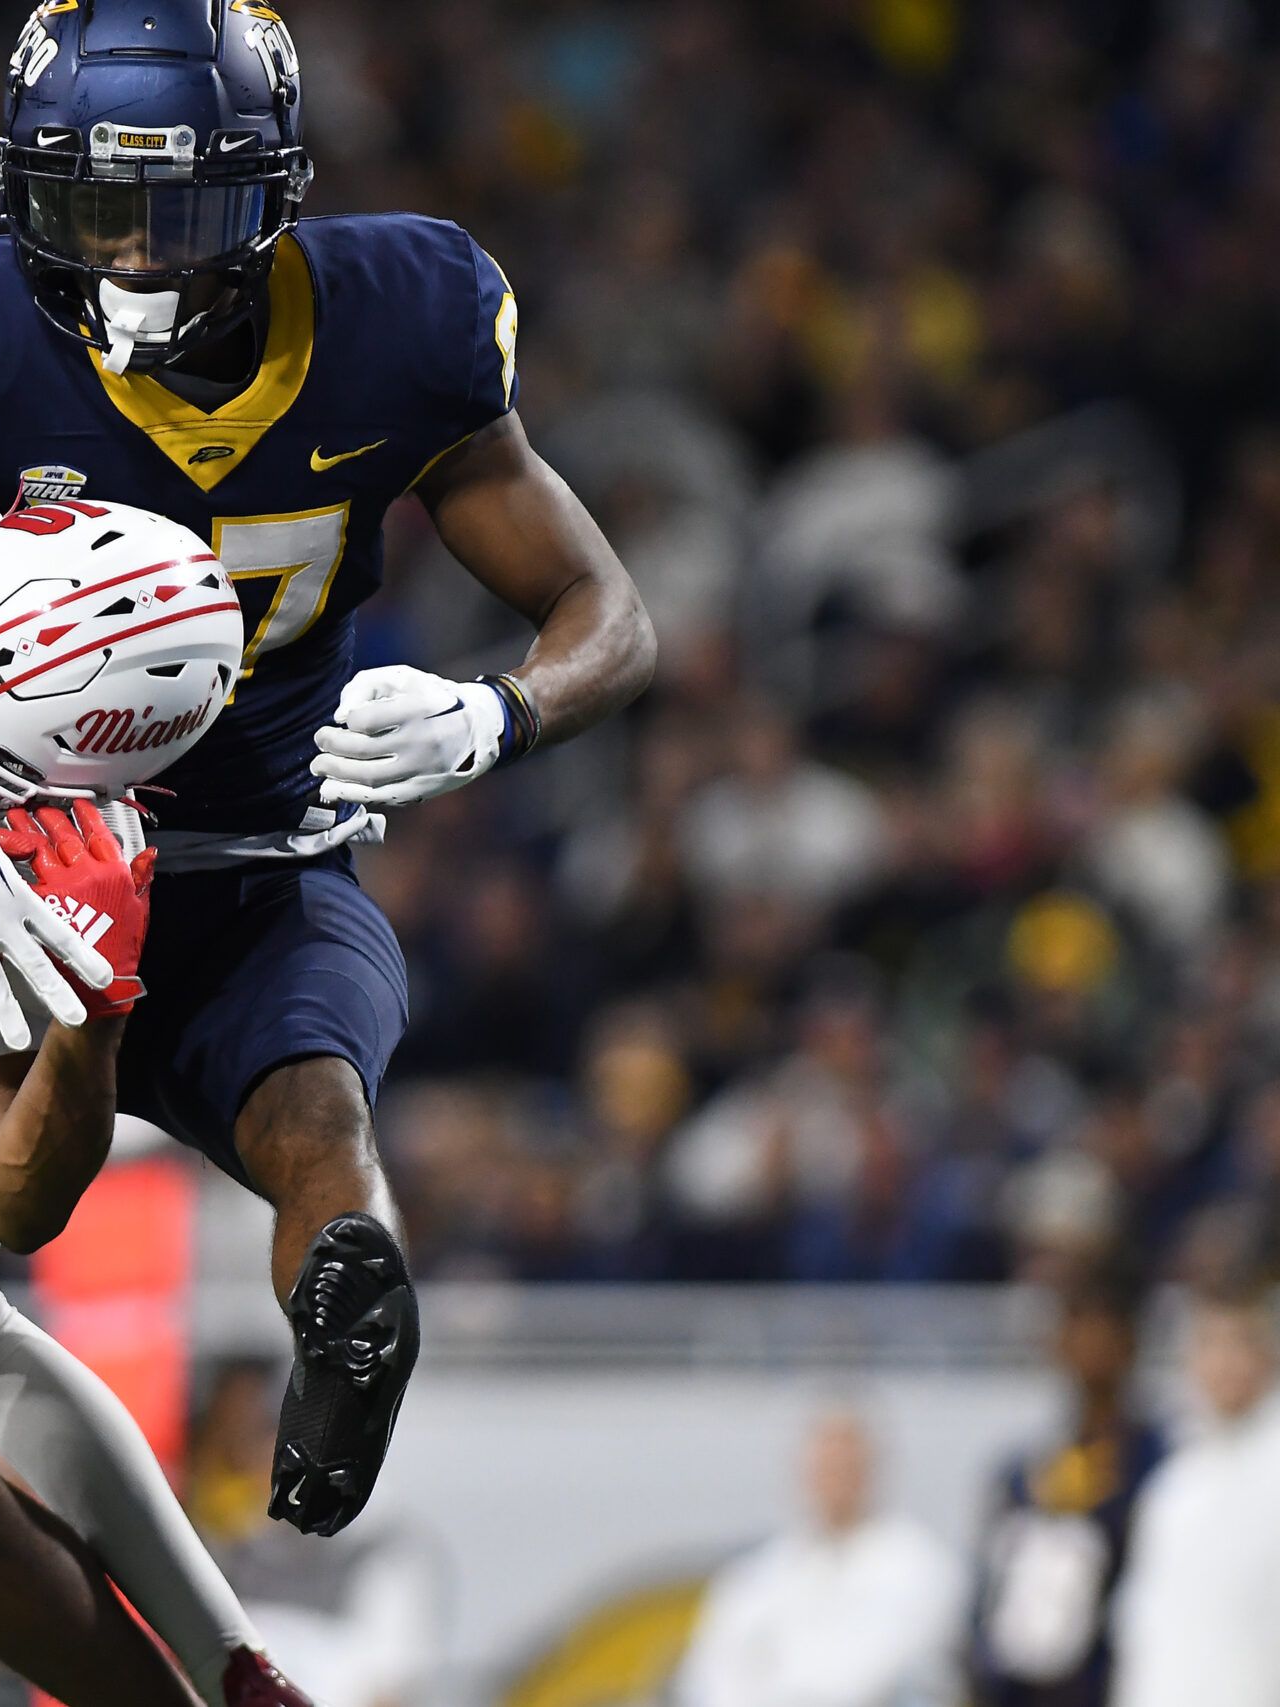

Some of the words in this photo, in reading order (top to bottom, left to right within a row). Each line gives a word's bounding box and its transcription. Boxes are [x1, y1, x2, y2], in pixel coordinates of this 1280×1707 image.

[120, 133, 144, 147] GLASS
[146, 136, 165, 148] CITY
[22, 482, 82, 500] MAC
[211, 499, 352, 690] 7
[75, 676, 218, 754] Miami
